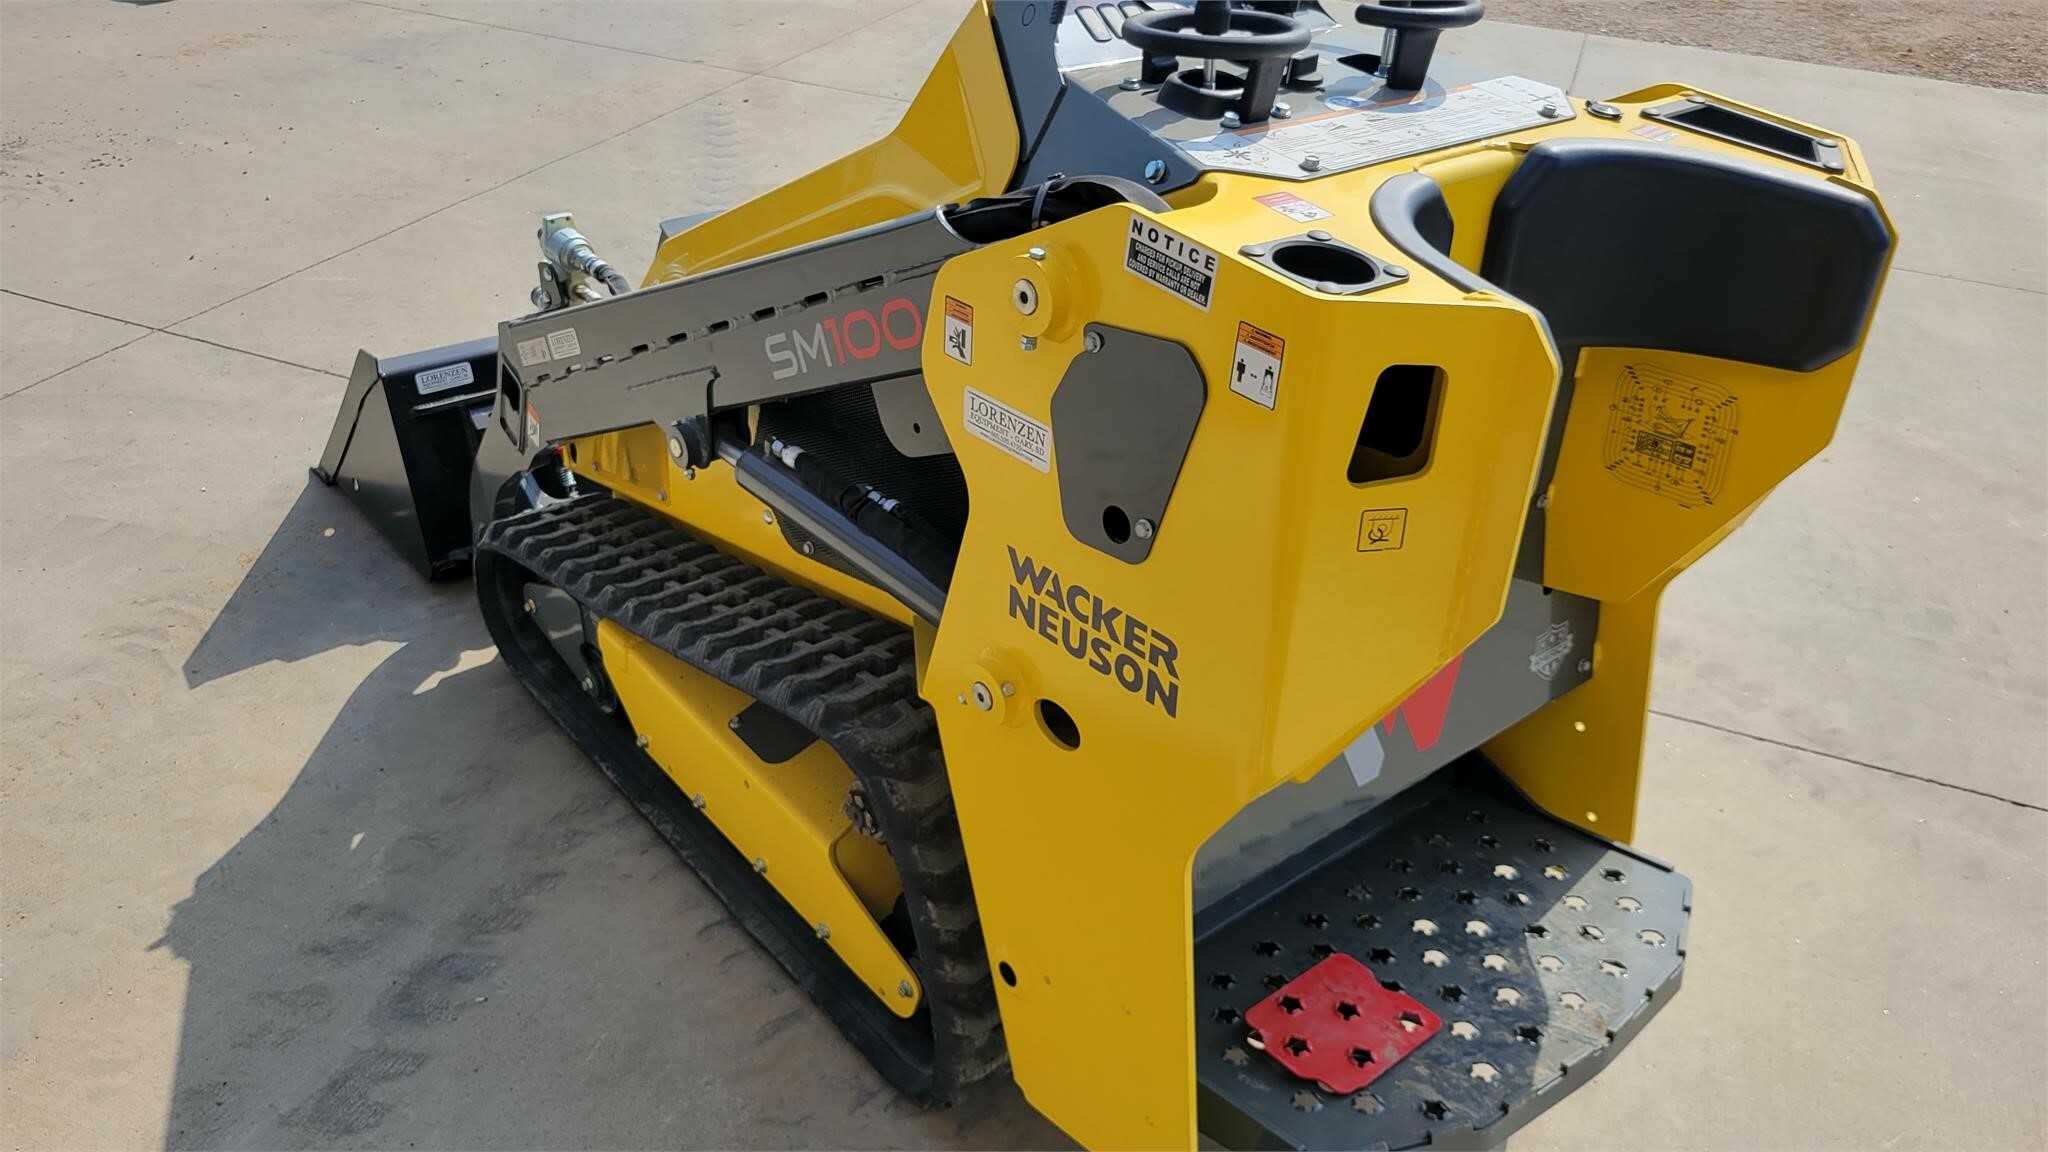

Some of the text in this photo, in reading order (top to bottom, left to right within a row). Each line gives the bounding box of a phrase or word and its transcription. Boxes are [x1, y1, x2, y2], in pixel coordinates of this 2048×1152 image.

[1132, 219, 1215, 272] NOTICE
[1135, 242, 1156, 260] CHARGES
[1156, 252, 1166, 263] FOR
[1183, 265, 1206, 284] DELIVERY
[1128, 258, 1149, 275] COVERED
[1156, 271, 1180, 291] WARRANTY
[1137, 253, 1201, 291] AND SERVICE CALLS ARE NOT
[765, 298, 923, 380] SM100
[421, 367, 468, 383] LORENZEN
[970, 396, 1046, 447] LORENZEN
[970, 412, 1009, 437] EQUIPMENT
[1015, 434, 1034, 452] GARY,
[1036, 447, 1045, 456] SD
[1007, 544, 1180, 681] WACKER
[1009, 584, 1179, 719] NEUSON
